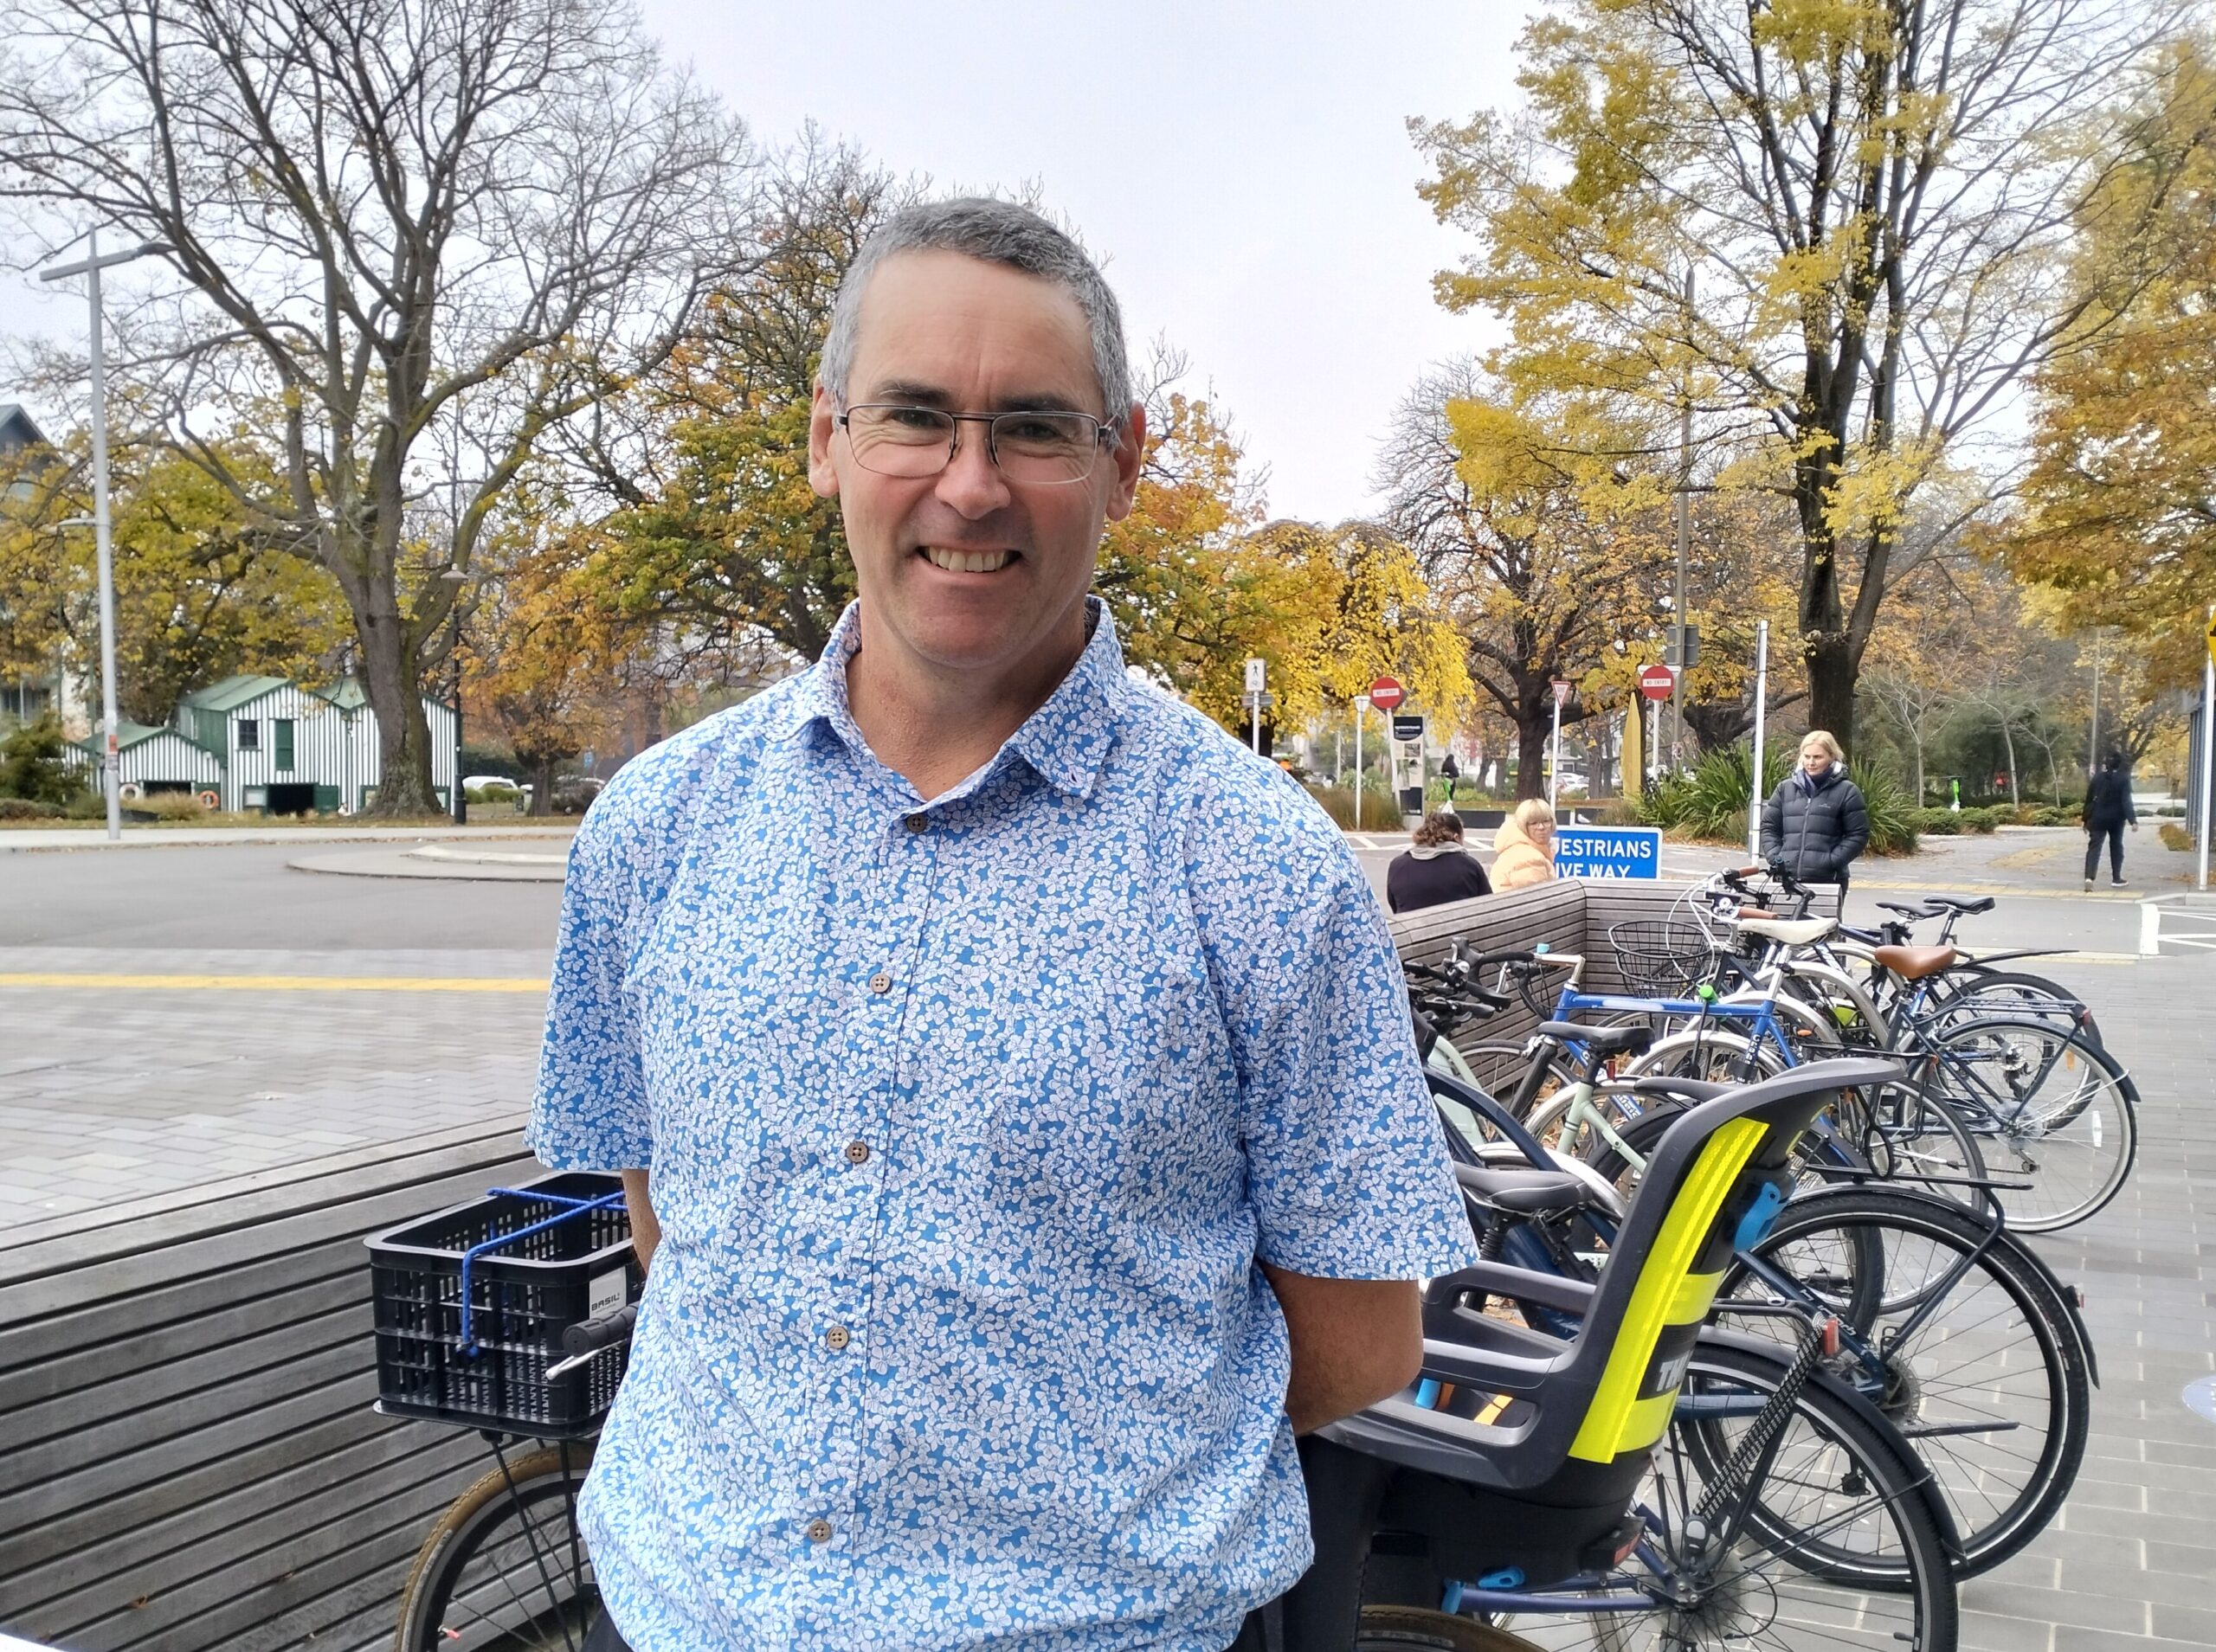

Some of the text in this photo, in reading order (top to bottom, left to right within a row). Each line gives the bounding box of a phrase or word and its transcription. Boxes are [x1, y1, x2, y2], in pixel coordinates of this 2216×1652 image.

[1556, 862, 1631, 878] IVE WAY
[591, 1293, 621, 1311] BASIL
